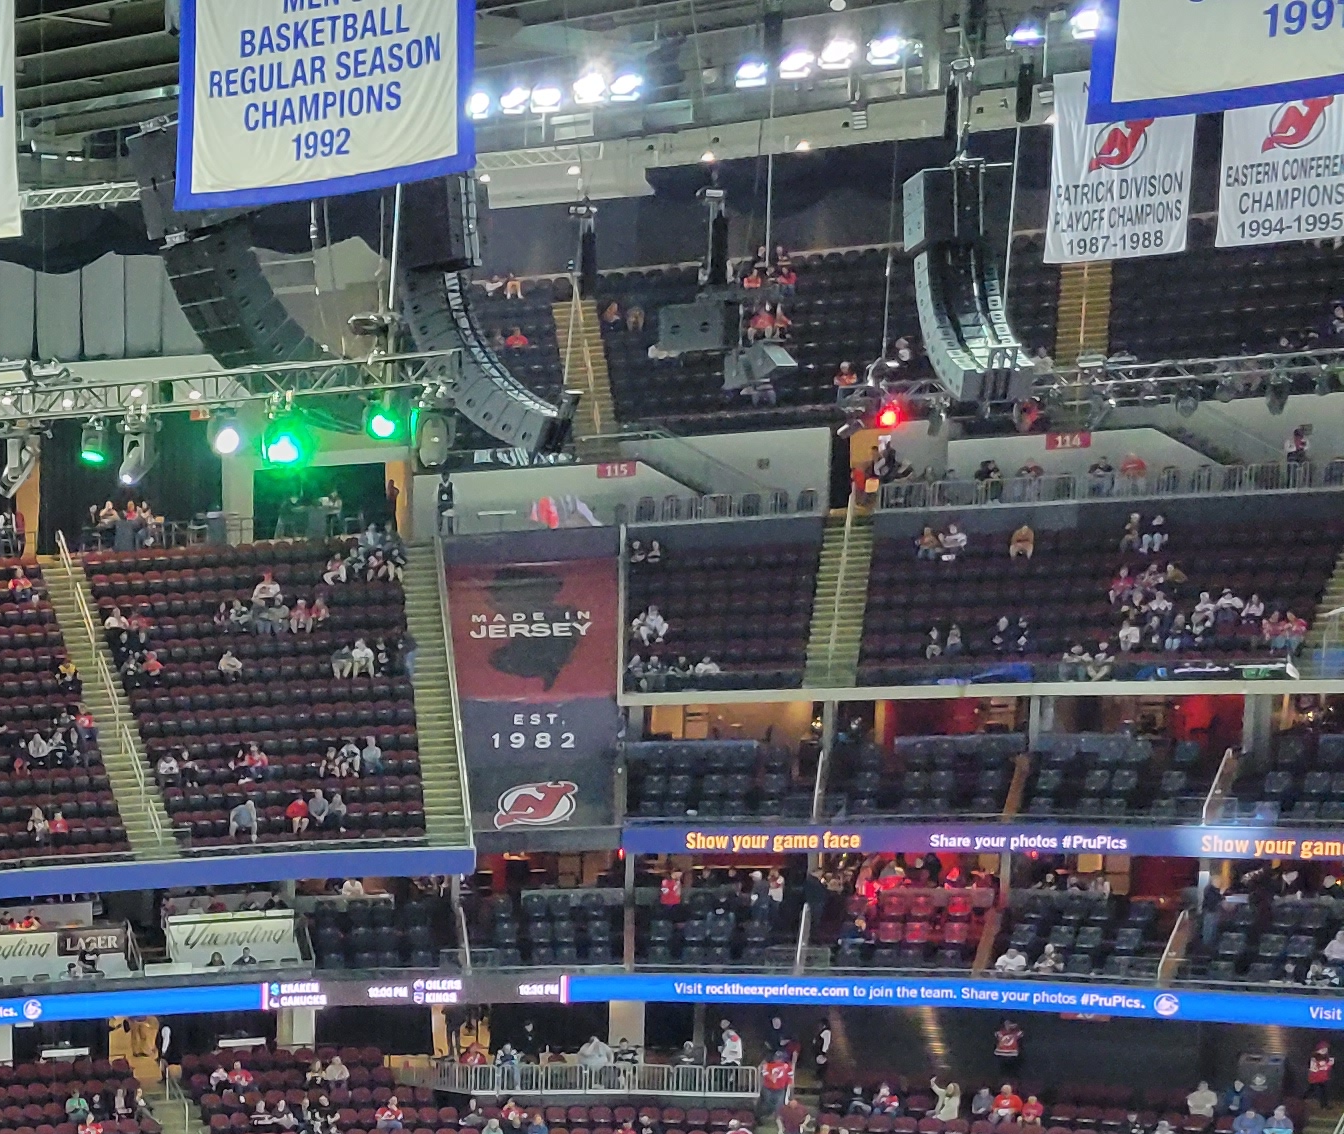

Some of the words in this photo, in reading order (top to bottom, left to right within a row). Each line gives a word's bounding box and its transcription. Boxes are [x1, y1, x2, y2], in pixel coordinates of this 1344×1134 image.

[240, 4, 410, 58] BASKETBALL
[209, 57, 326, 98] REGULAR
[336, 33, 441, 80] SEASON
[244, 81, 402, 132] CHAMPIONS
[292, 127, 350, 161] 1992
[1056, 180, 1116, 205] PATRICK
[1119, 171, 1183, 198] DIVISION
[1226, 166, 1278, 188] EASTERN
[1239, 182, 1344, 215] CHAMPIONS
[1054, 208, 1105, 233] PLAYOFF
[1109, 199, 1182, 225] CHAMPIONS
[1237, 214, 1343, 239] 1994-1995
[1066, 230, 1163, 256] 1987-1988
[1054, 433, 1082, 449] 114
[605, 464, 628, 477] 115
[471, 611, 545, 622] MADE
[564, 610, 591, 620] IN
[469, 621, 592, 638] JERSEY
[514, 713, 566, 726] EST.
[492, 732, 575, 749] 1982
[685, 832, 727, 849] Show
[732, 834, 769, 851] your
[773, 833, 818, 852] game
[823, 831, 860, 848] face
[930, 834, 971, 847] Share
[974, 836, 1006, 850] your
[1010, 835, 1057, 850] photos
[1062, 836, 1127, 849] #PruPics
[177, 924, 287, 950] Yuengling
[674, 982, 702, 995] Visit
[706, 983, 849, 998] rocktheexperience.com
[853, 987, 865, 997] to
[868, 985, 893, 1000] join
[897, 986, 917, 998] the
[920, 987, 957, 999] team.
[961, 988, 998, 1001] Share
[1001, 991, 1030, 1003] your
[1033, 991, 1076, 1005] photos
[1081, 992, 1145, 1009] #PruPics.
[1310, 1006, 1342, 1021] Visit
